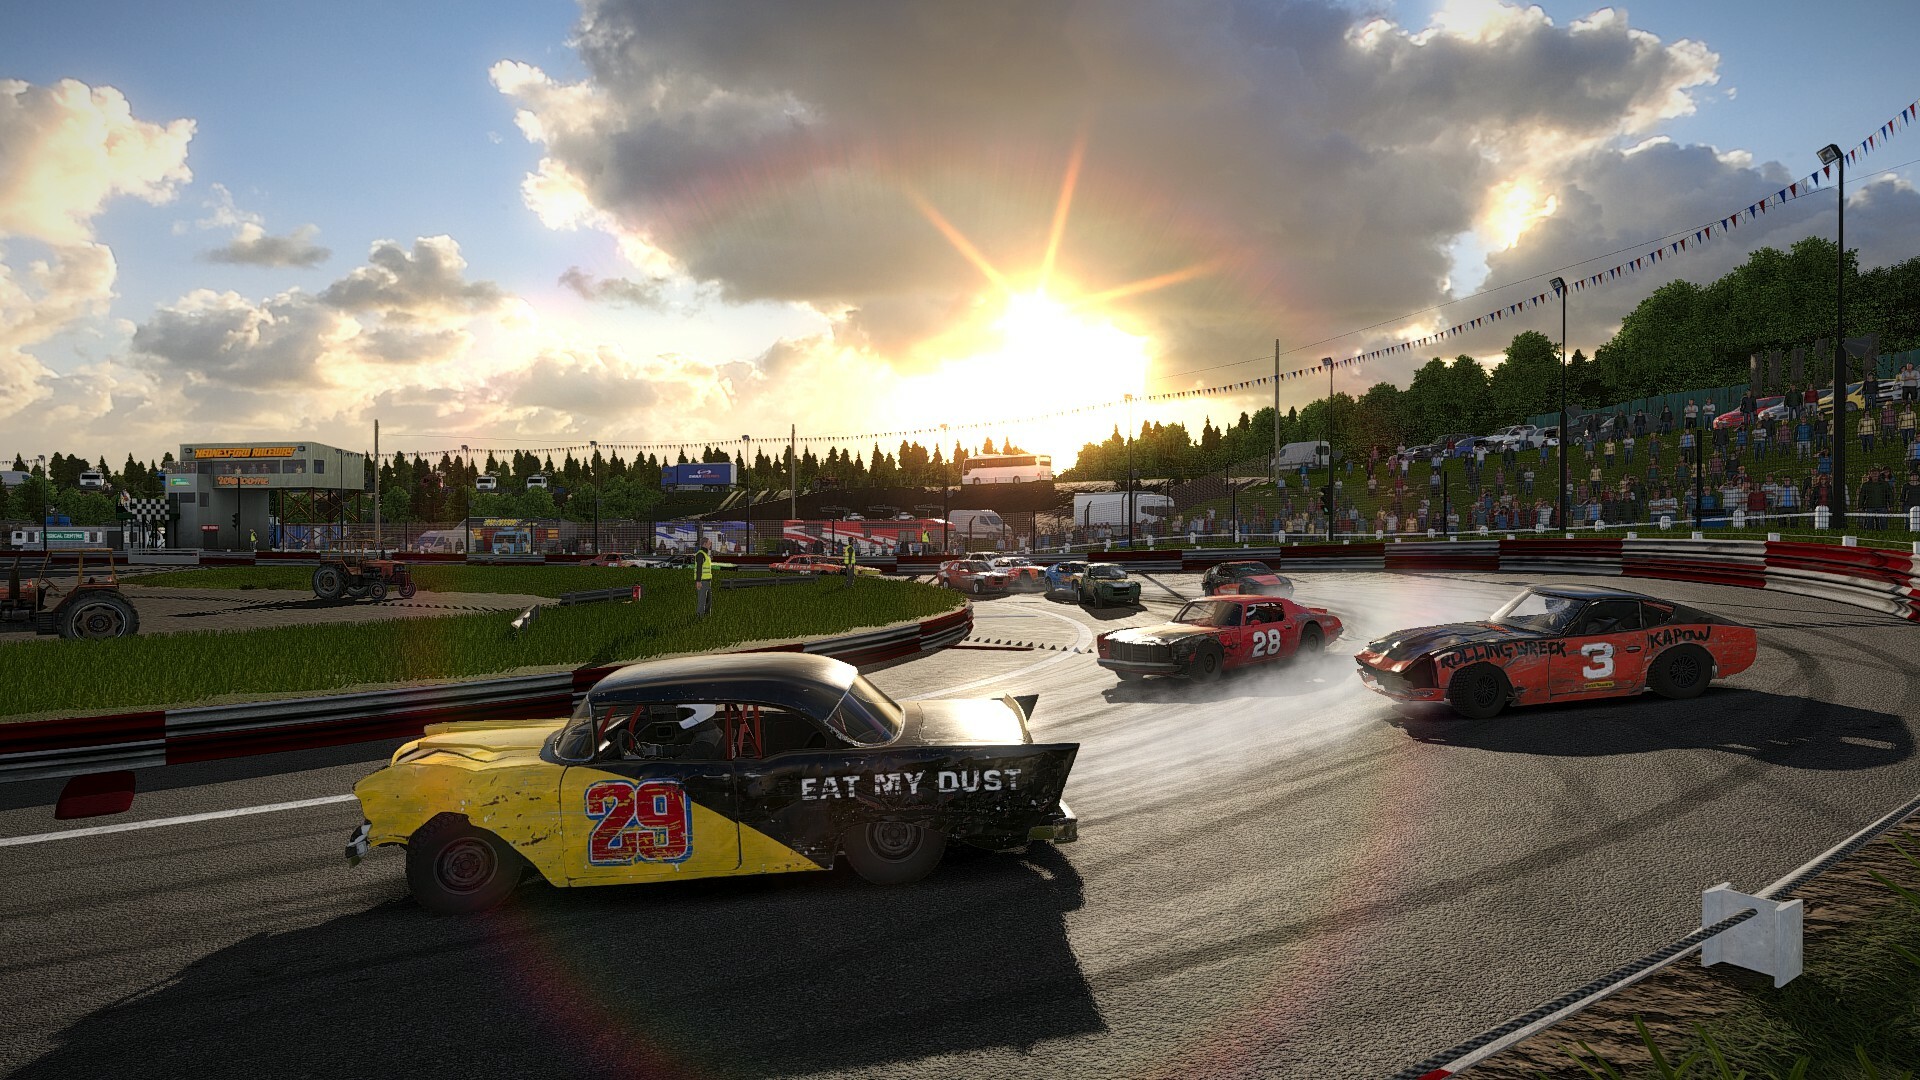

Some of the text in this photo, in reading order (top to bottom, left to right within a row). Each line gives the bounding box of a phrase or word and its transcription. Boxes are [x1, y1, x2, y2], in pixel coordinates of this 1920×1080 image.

[195, 447, 296, 459] HEDNESFORD RACEWAY
[1252, 629, 1280, 657] 28
[1649, 626, 1711, 649] KAPOW
[1440, 641, 1567, 668] ROLLING WRECK
[1580, 642, 1614, 679] 3
[801, 768, 1022, 800] EAT MY DUST
[584, 778, 693, 867] 29
